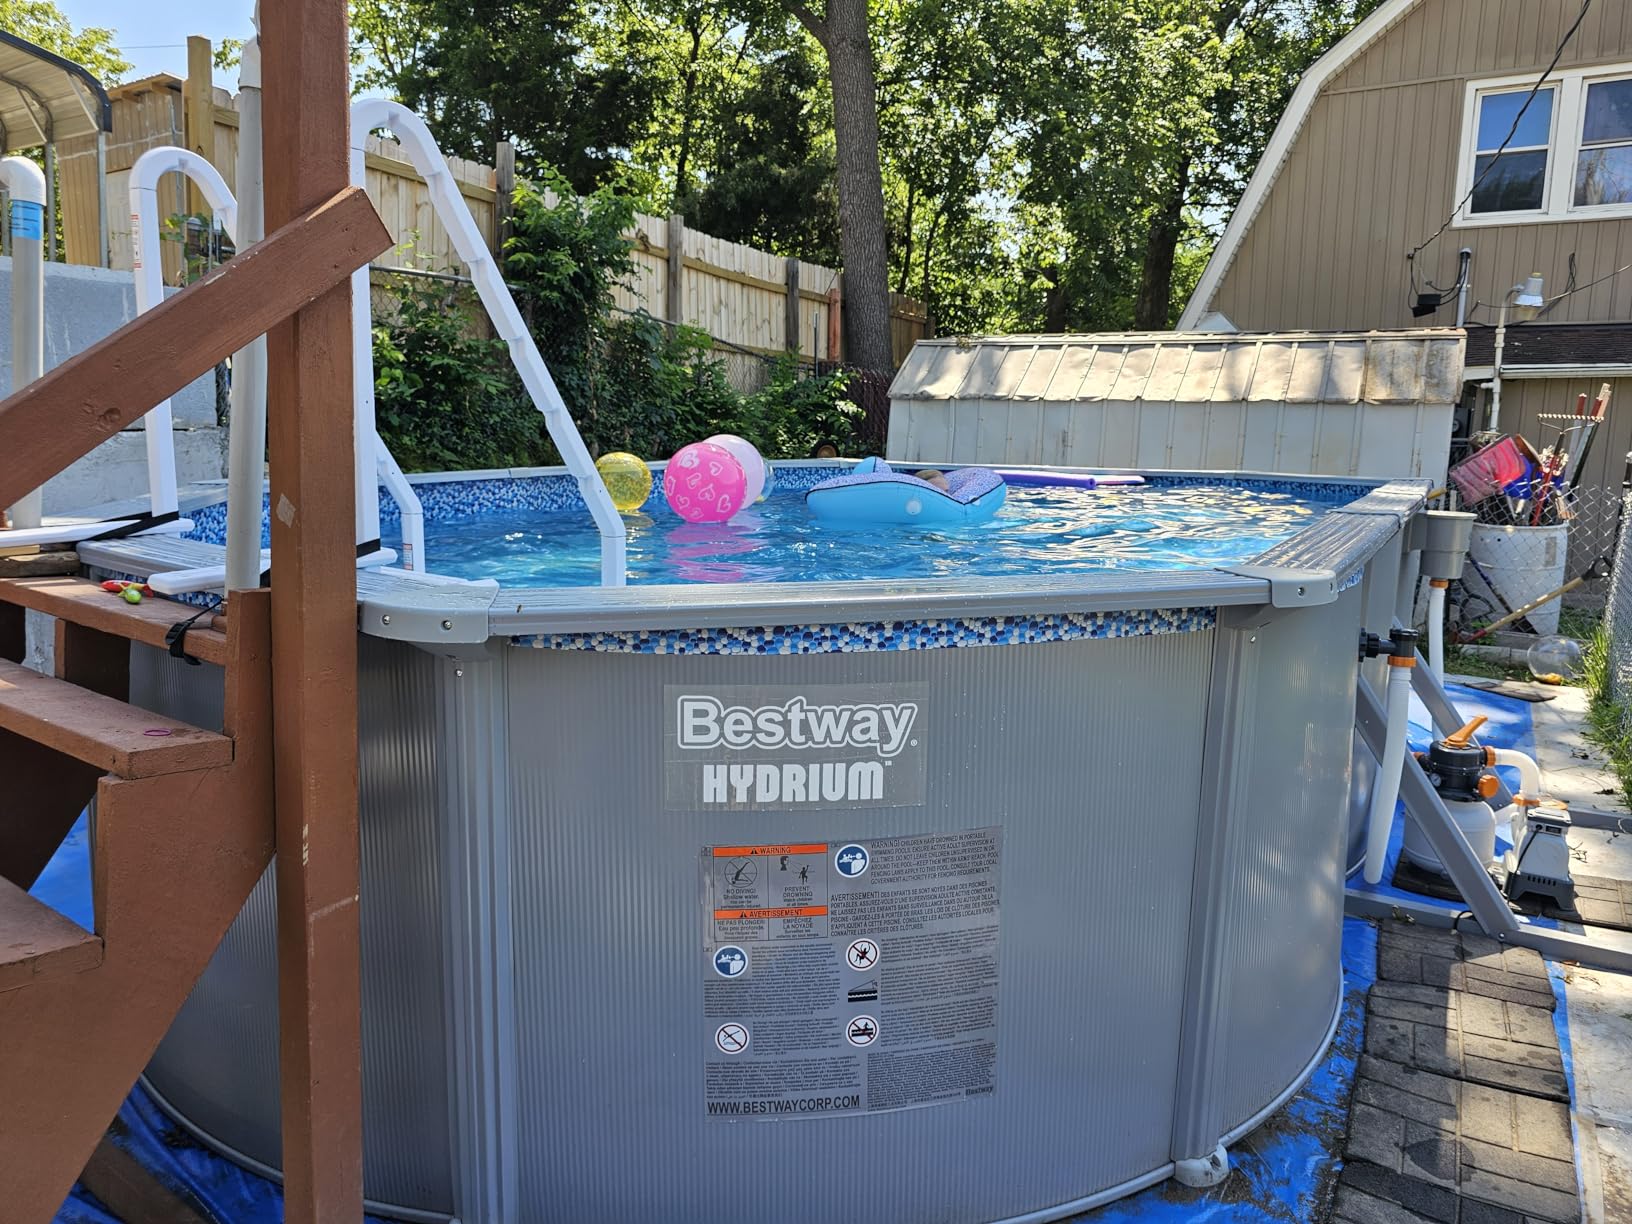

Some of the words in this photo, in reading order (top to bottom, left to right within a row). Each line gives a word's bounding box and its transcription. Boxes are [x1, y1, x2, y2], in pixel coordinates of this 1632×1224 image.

[678, 695, 918, 757] Bestway
[703, 761, 884, 803] HYDRIUM
[760, 846, 791, 854] WARNING
[749, 909, 803, 918] AVERTISSEMENT
[707, 1095, 860, 1114] WWW.BESTWAYCORP.COM
